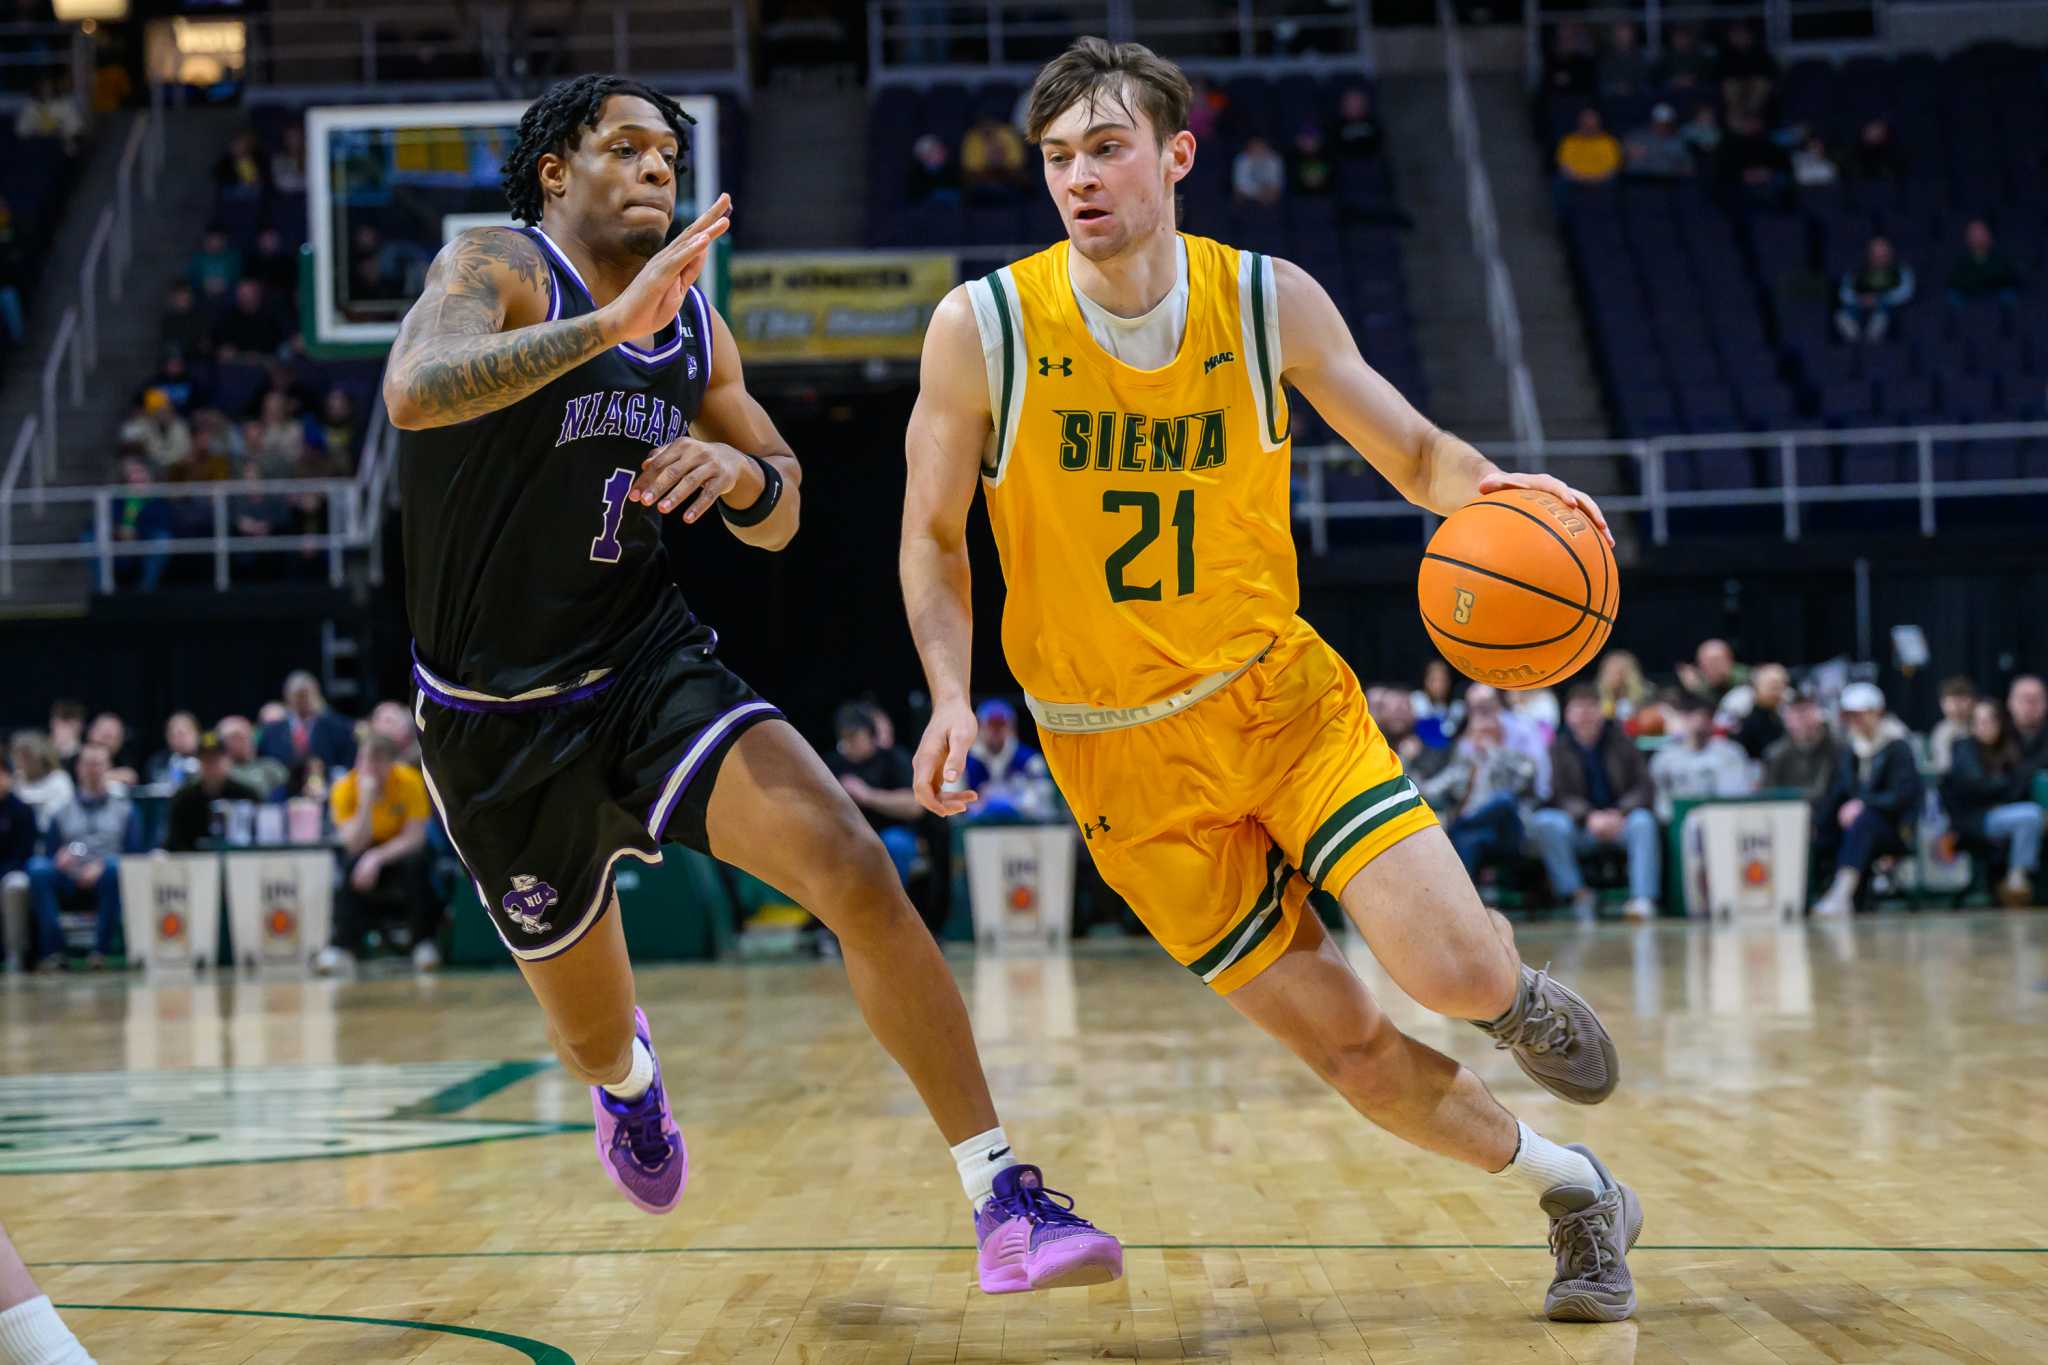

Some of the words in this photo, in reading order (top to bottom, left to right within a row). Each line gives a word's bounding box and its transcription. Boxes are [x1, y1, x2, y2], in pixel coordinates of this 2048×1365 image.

[1203, 351, 1235, 375] MAAC
[1052, 409, 1228, 472] SIENA
[590, 467, 636, 563] 1
[1102, 489, 1195, 603] 21
[1453, 587, 1476, 625] S
[1046, 705, 1150, 727] UNDER
[524, 892, 543, 907] NU
